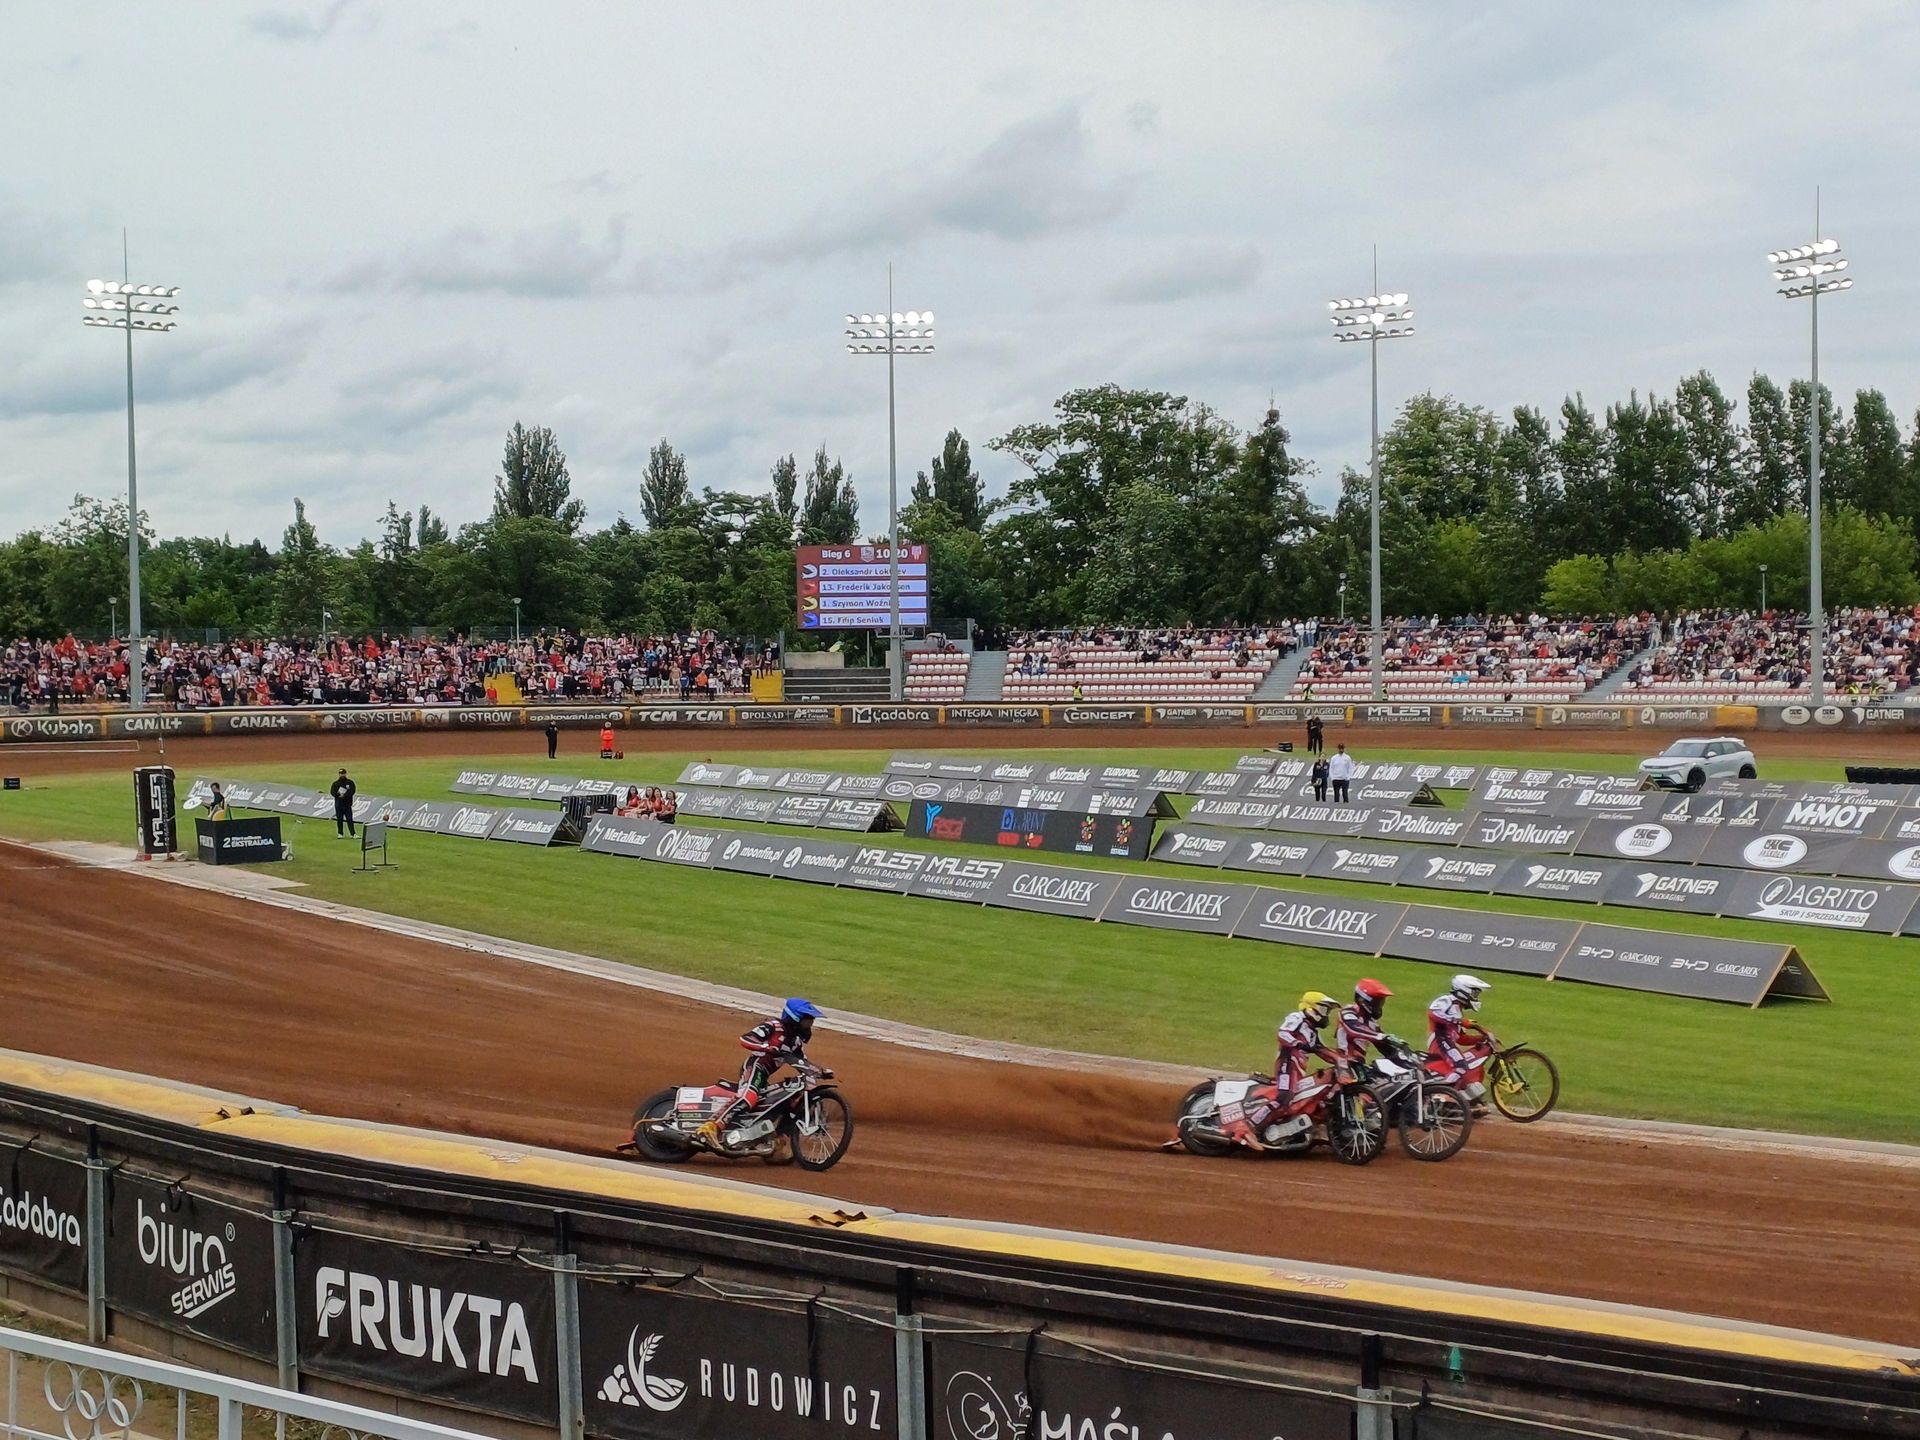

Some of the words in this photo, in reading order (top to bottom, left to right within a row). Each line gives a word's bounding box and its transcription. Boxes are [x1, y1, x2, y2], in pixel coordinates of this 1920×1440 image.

[844, 549, 851, 558] 6
[832, 567, 873, 576] Oleksandr
[837, 583, 871, 591] Frederik
[832, 600, 864, 609] Szymon
[338, 712, 356, 724] SK
[359, 711, 412, 724] SYSTEM
[459, 710, 512, 723] OSTRÓW
[638, 710, 678, 722] TCM
[685, 710, 724, 722] TCM
[749, 711, 784, 720] POLSAD
[951, 708, 993, 718] INTEGRA
[998, 708, 1039, 718] INTEGRA
[1070, 711, 1136, 721] CONCEPT
[1167, 708, 1197, 716] GATNER
[1213, 708, 1244, 717] GATNER
[1266, 708, 1297, 716] AGRITO
[1314, 707, 1344, 716] AGRITO
[1367, 706, 1431, 717] MALESA
[1462, 706, 1524, 717] MALESA
[1570, 710, 1621, 720] moonfin.pl
[1659, 710, 1709, 720] moonfin.pl
[1866, 709, 1905, 720] GATNER
[37, 719, 94, 735] Kubota
[124, 717, 183, 731] CANAL+
[229, 716, 289, 729] CANAL+
[803, 773, 831, 784] SYSTEM
[853, 777, 885, 788] SYSTEM
[1152, 769, 1190, 785] PLATIN
[1202, 772, 1241, 788] PLATIN
[1254, 775, 1296, 791] PLATIN
[1363, 789, 1413, 800] CONCEPT
[1498, 788, 1550, 801] TASOMIX
[1591, 793, 1646, 807] TASOMIX
[150, 773, 165, 847] MALESA
[780, 796, 830, 811] MALESA
[829, 799, 883, 815] MALESA
[1203, 800, 1241, 815] ZAHIR
[1240, 802, 1277, 817] KEBAB
[1289, 806, 1329, 821] ZAHIR
[1328, 808, 1370, 824] KEBAB
[512, 819, 557, 834] Metalkas
[1395, 813, 1464, 837] Polkurier
[602, 827, 650, 846] Metalkas
[1500, 822, 1576, 846] Polkurier
[222, 837, 231, 848] 2
[1184, 836, 1227, 852] GATNER
[739, 845, 785, 863] moonfin.pl
[855, 848, 927, 871] MALESA
[1263, 844, 1309, 860] GATNER
[801, 853, 850, 872] moonfin.pl
[926, 855, 1004, 880] MALESA
[1348, 852, 1399, 869] GATNER
[1442, 860, 1497, 877] GATNER
[849, 865, 882, 876] POKRYCIA
[881, 869, 915, 882] DACHOWE
[1543, 868, 1603, 886] GATNER
[919, 874, 955, 886] POKRYCIA
[955, 878, 993, 890] DACHOWE
[1012, 873, 1100, 902] GARCAREK
[1654, 876, 1720, 896] GATNER
[1130, 887, 1230, 917] GARCAREK
[1648, 892, 1687, 902] PACKAGING
[1787, 883, 1879, 911] AGRITO
[1265, 901, 1378, 936] GARCAREK
[1778, 908, 1800, 918] SKUP
[1805, 911, 1845, 923] SPRZEDAŻ
[1403, 925, 1435, 938] BYD
[1439, 929, 1475, 942] GARCAREK
[1481, 935, 1515, 948] BYD
[1519, 938, 1558, 951] GARCAREK
[1578, 946, 1615, 959] BYD
[1619, 950, 1663, 965] GARCAREK
[1670, 958, 1710, 971] BYD
[1715, 962, 1761, 977] GARCAREK
[0, 1186, 81, 1247] adabra
[137, 1198, 226, 1276] biuro
[171, 1263, 236, 1315] SERWIS
[315, 1266, 540, 1384] FRUKTA
[700, 1357, 882, 1431] RUDOWICZ
